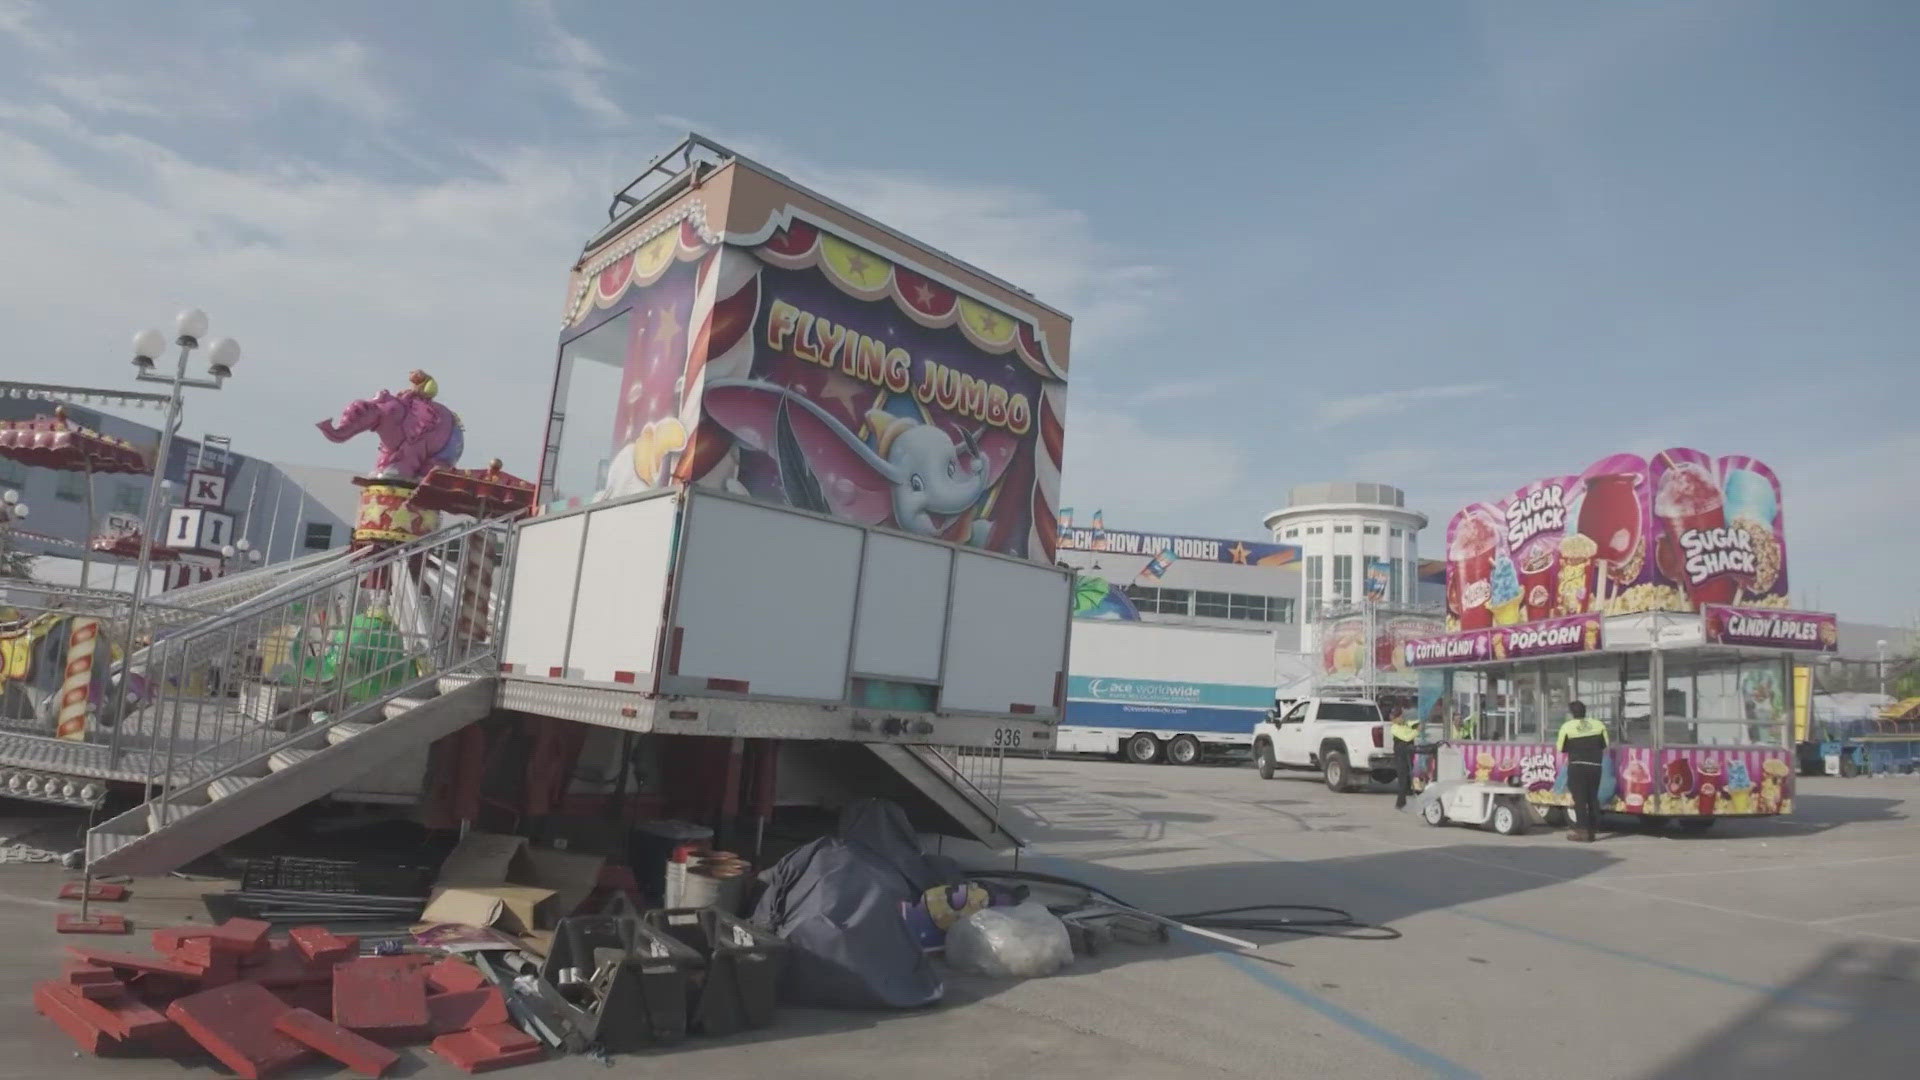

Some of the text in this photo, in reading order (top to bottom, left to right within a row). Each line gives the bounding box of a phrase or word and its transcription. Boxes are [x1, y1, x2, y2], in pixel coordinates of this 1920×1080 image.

[767, 299, 1031, 435] FLYING JUMBO
[197, 480, 218, 500] K
[1505, 485, 1563, 528] SUGAR
[1508, 508, 1565, 552] SHACK
[1104, 532, 1140, 555] HOW
[1142, 536, 1171, 555] AND
[1174, 538, 1219, 561] RODEO
[1680, 528, 1751, 558] SUGAR
[1686, 550, 1756, 584] SHACK
[1509, 625, 1581, 650] POPCORN
[1729, 615, 1817, 641] CANDY APPLES
[1416, 639, 1474, 659] COTTON CANDY
[1109, 683, 1132, 693] ace
[994, 728, 1021, 747] 936
[1520, 752, 1555, 771] SUGAR
[1521, 767, 1556, 788] SHACK
